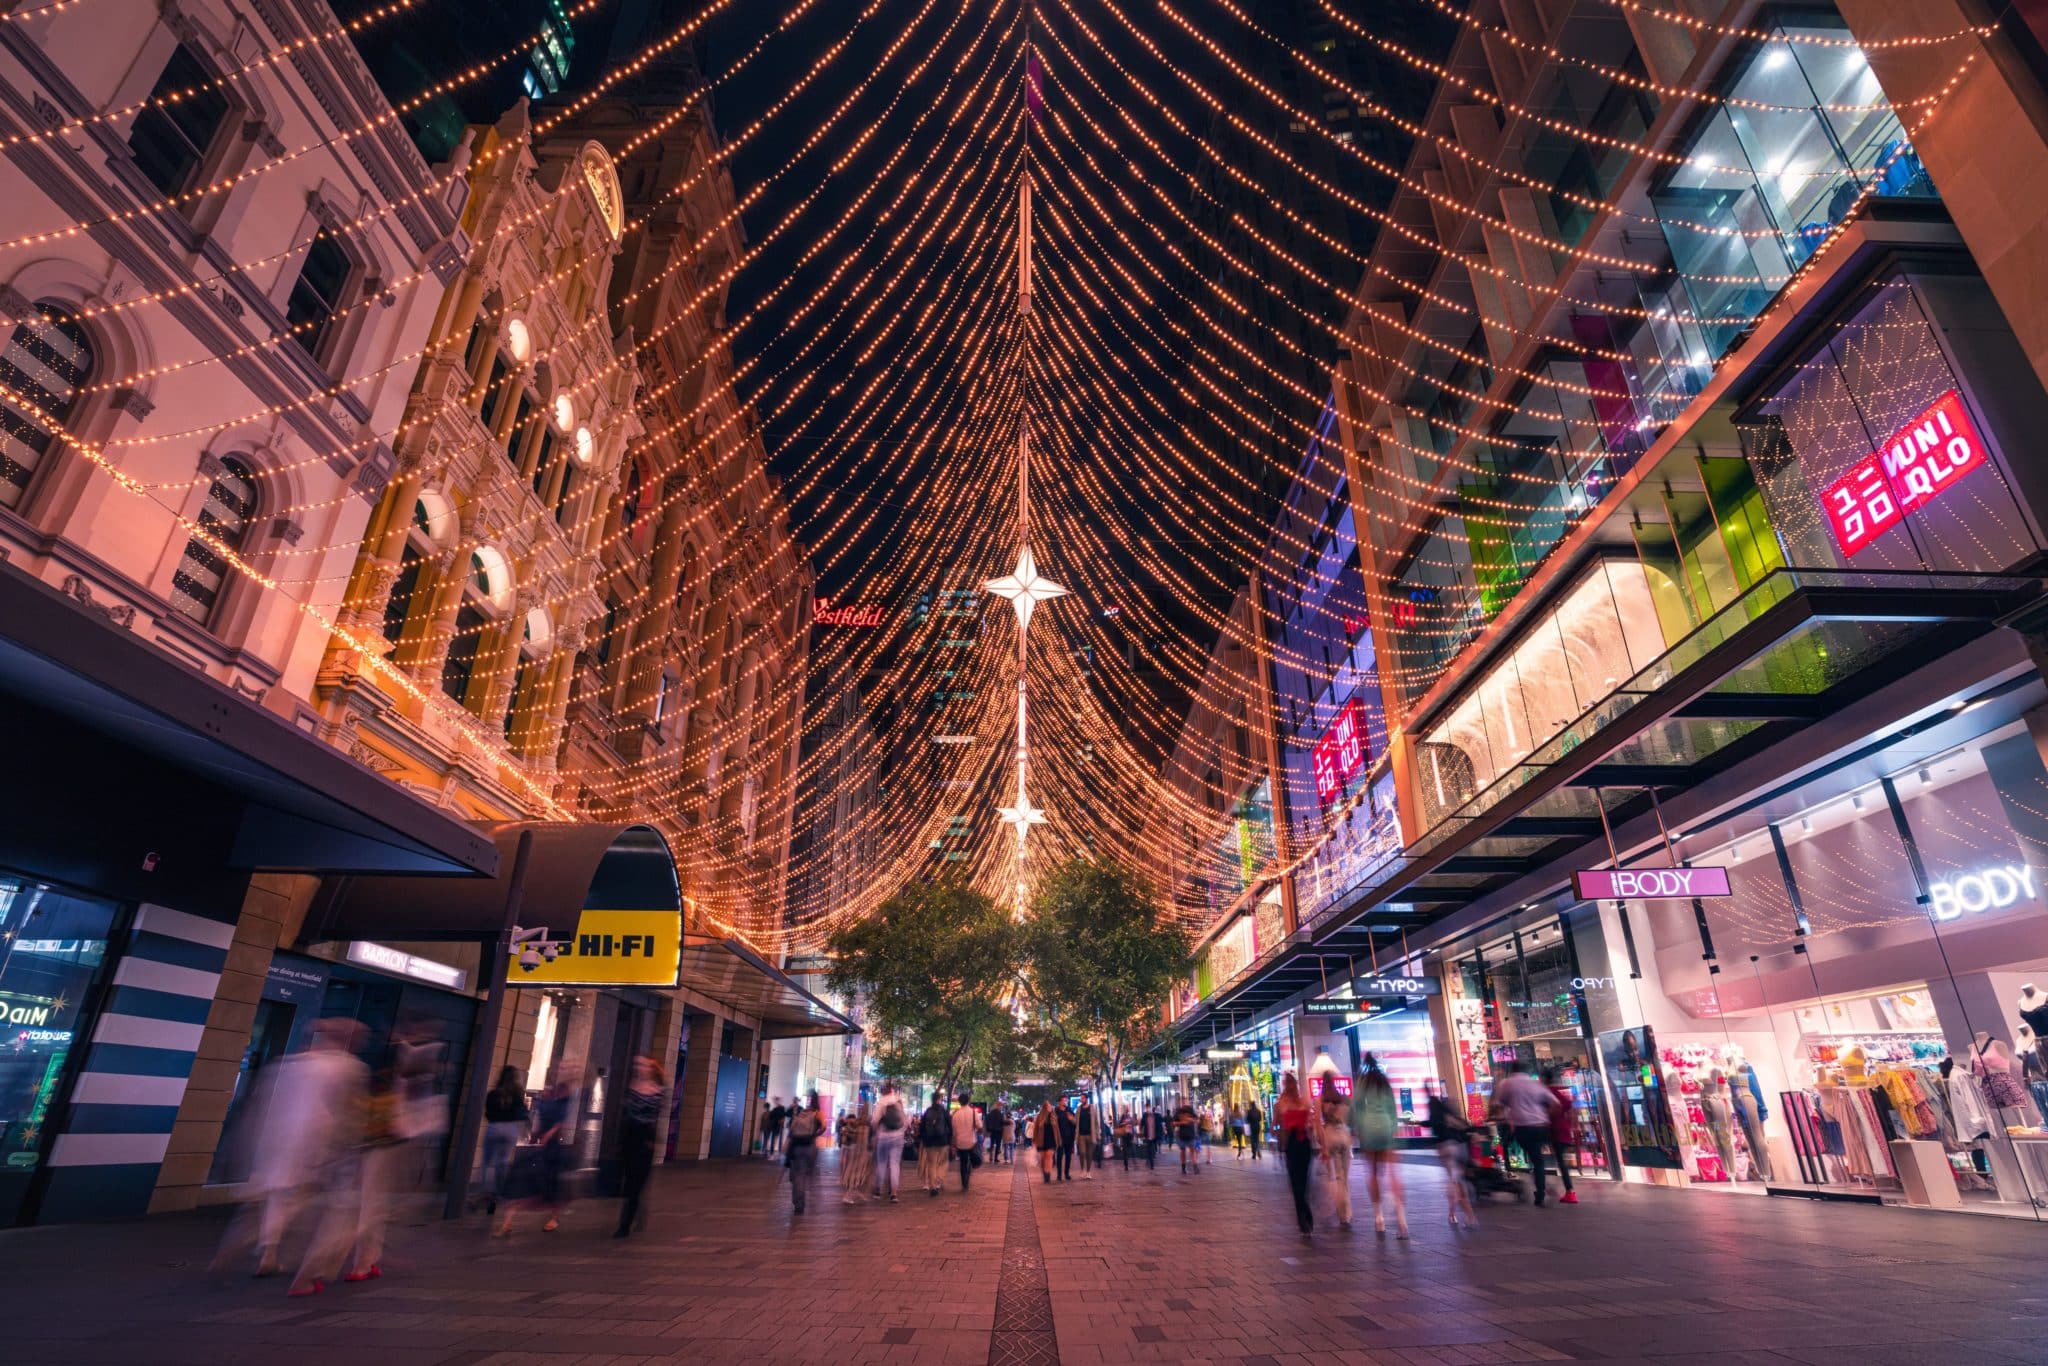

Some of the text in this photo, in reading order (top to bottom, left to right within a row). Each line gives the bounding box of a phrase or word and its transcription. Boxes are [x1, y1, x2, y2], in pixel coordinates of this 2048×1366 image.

[1895, 410, 1953, 466] UNI
[1907, 436, 1971, 494] QLO
[1833, 466, 1883, 516] ユニ
[813, 597, 885, 626] Westfield
[1336, 711, 1354, 746] UNI
[1341, 736, 1359, 774] QLO
[1617, 871, 1693, 896] BODY
[1929, 864, 2036, 920] BODY
[361, 943, 408, 969] BABYLON
[1235, 1042, 1257, 1050] rebel
